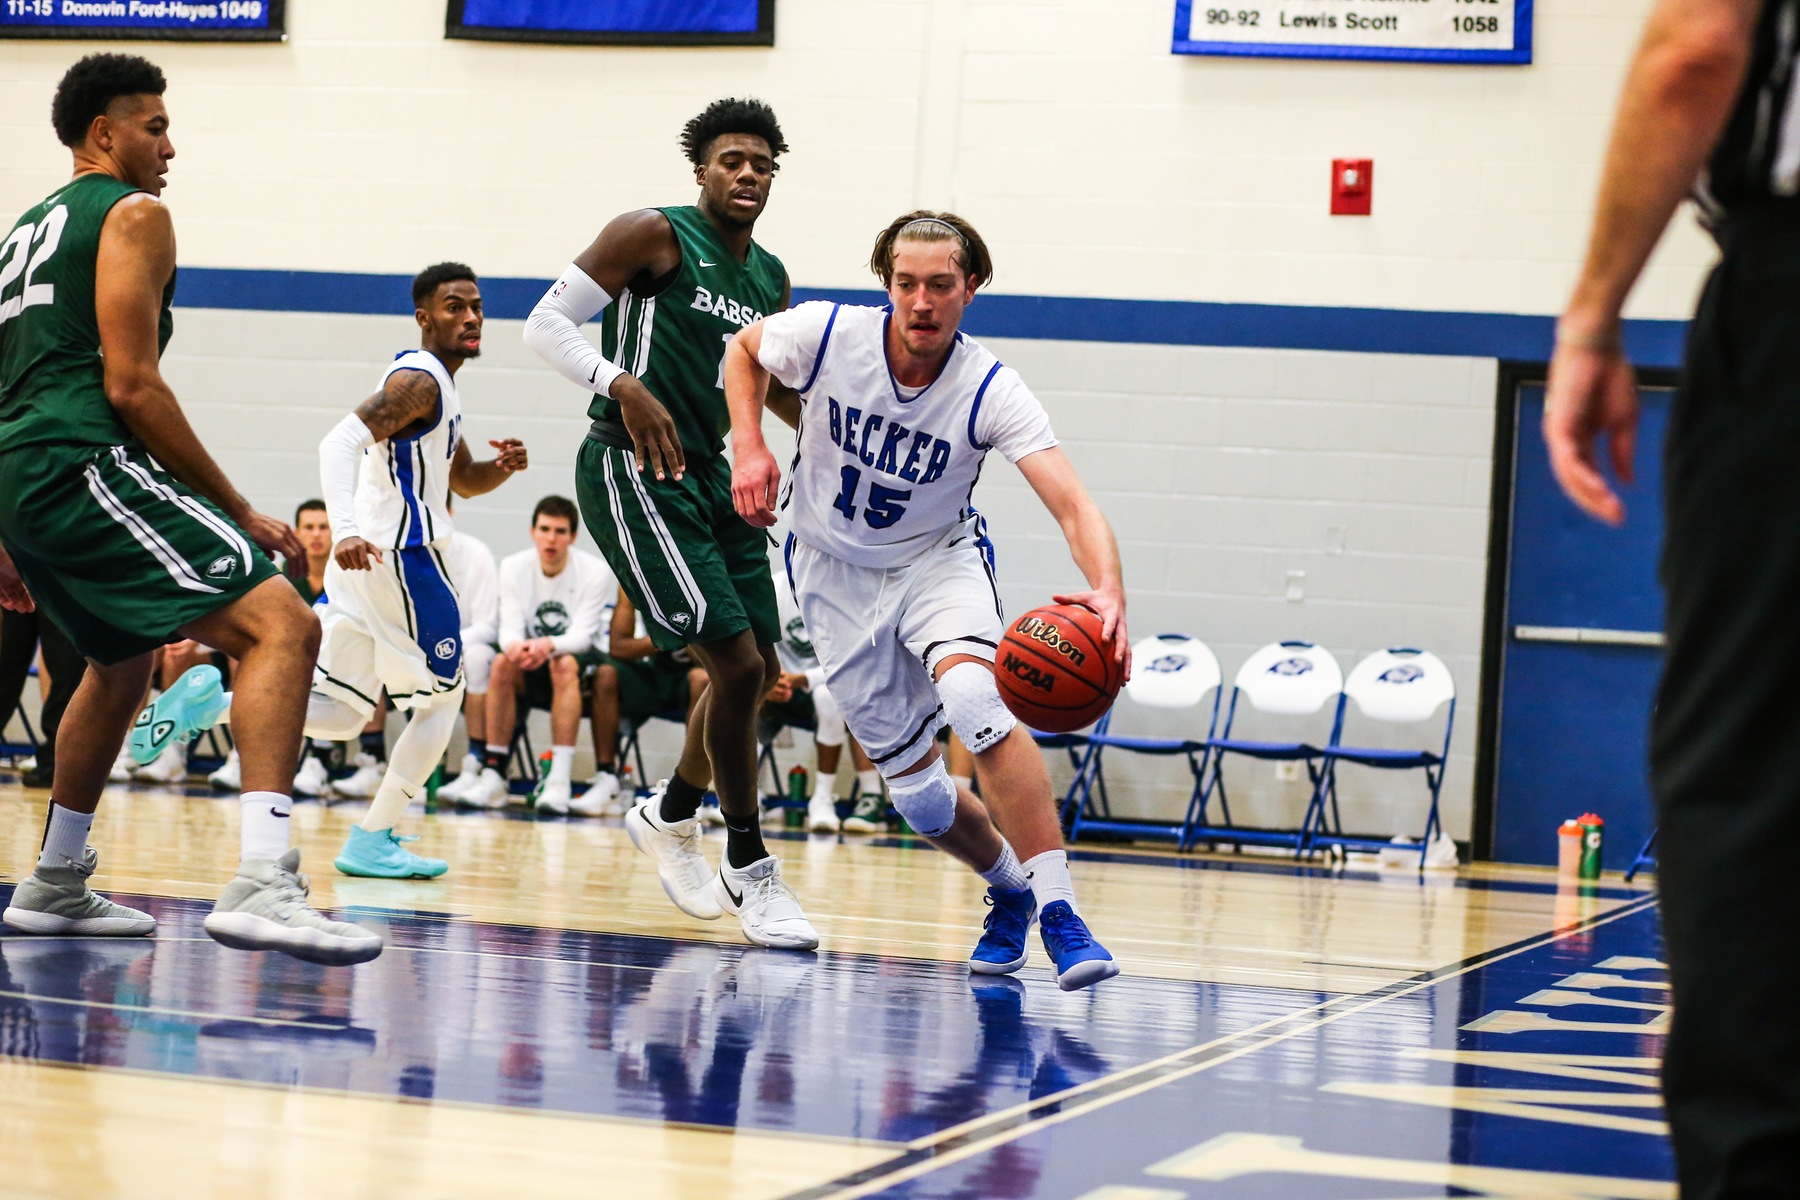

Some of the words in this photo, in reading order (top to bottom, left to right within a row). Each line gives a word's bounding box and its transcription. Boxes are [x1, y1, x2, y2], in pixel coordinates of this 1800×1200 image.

[8, 0, 53, 16] 11-15
[62, 0, 126, 17] Donovin
[129, 1, 218, 22] Ford-Hayes
[220, 1, 262, 19] 1049
[1206, 8, 1260, 26] 90-92
[1280, 11, 1337, 29] Lewis
[1346, 13, 1397, 31] Scott
[1452, 17, 1499, 33] 1058
[0, 204, 68, 324] 22
[828, 396, 951, 485] BECKER
[832, 464, 912, 530] 15
[1014, 616, 1087, 667] Wilson
[1002, 651, 1056, 693] NCAA
